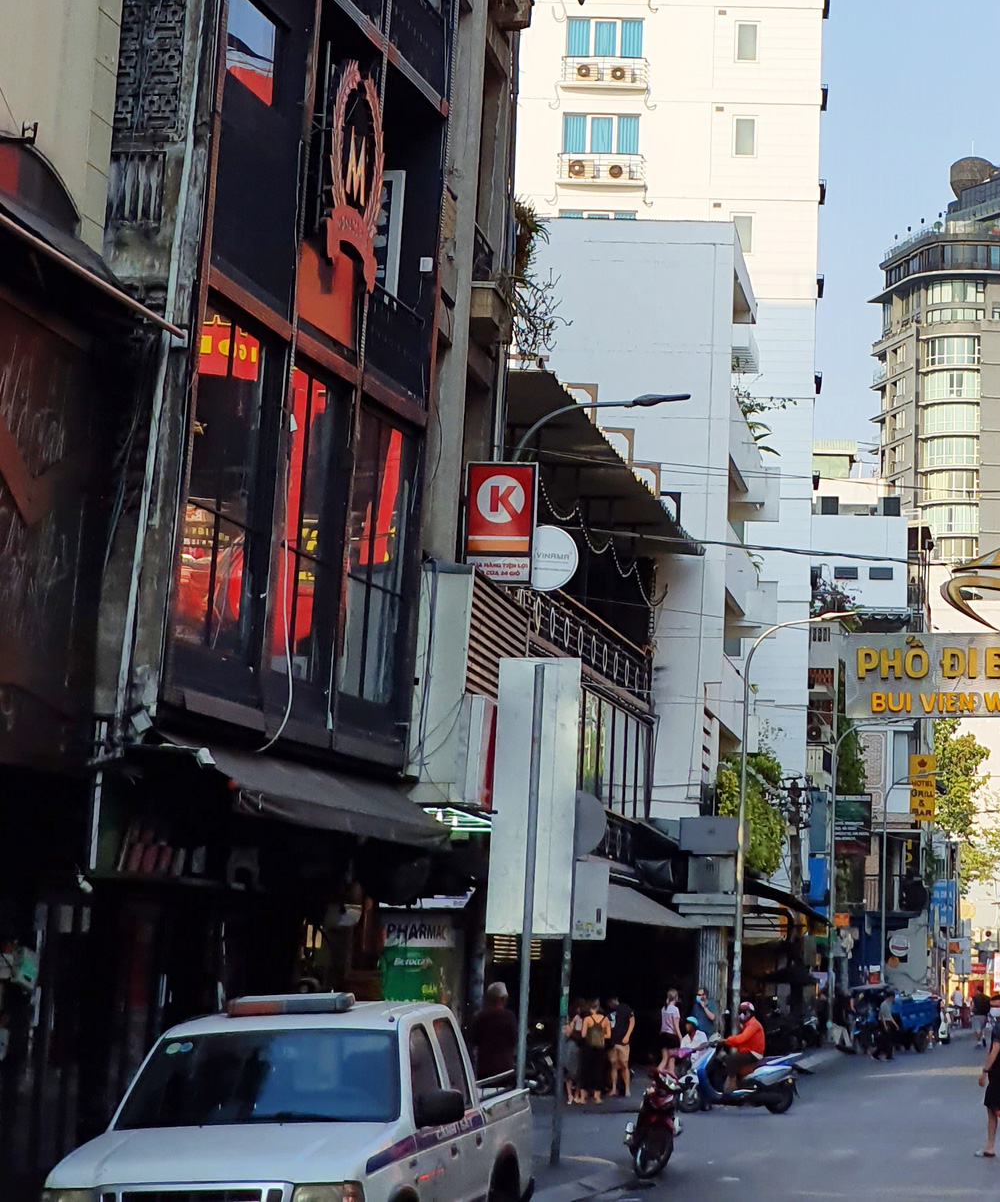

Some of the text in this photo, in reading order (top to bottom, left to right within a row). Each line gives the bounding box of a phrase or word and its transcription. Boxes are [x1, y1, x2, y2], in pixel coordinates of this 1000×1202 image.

[489, 485, 521, 520] K
[857, 635, 930, 679] PHỐ
[940, 647, 977, 679] ĐI
[871, 691, 912, 713] BUI
[918, 691, 976, 713] VIEN
[911, 788, 934, 798] GRILL
[918, 799, 926, 808] &
[911, 808, 932, 817] BAR
